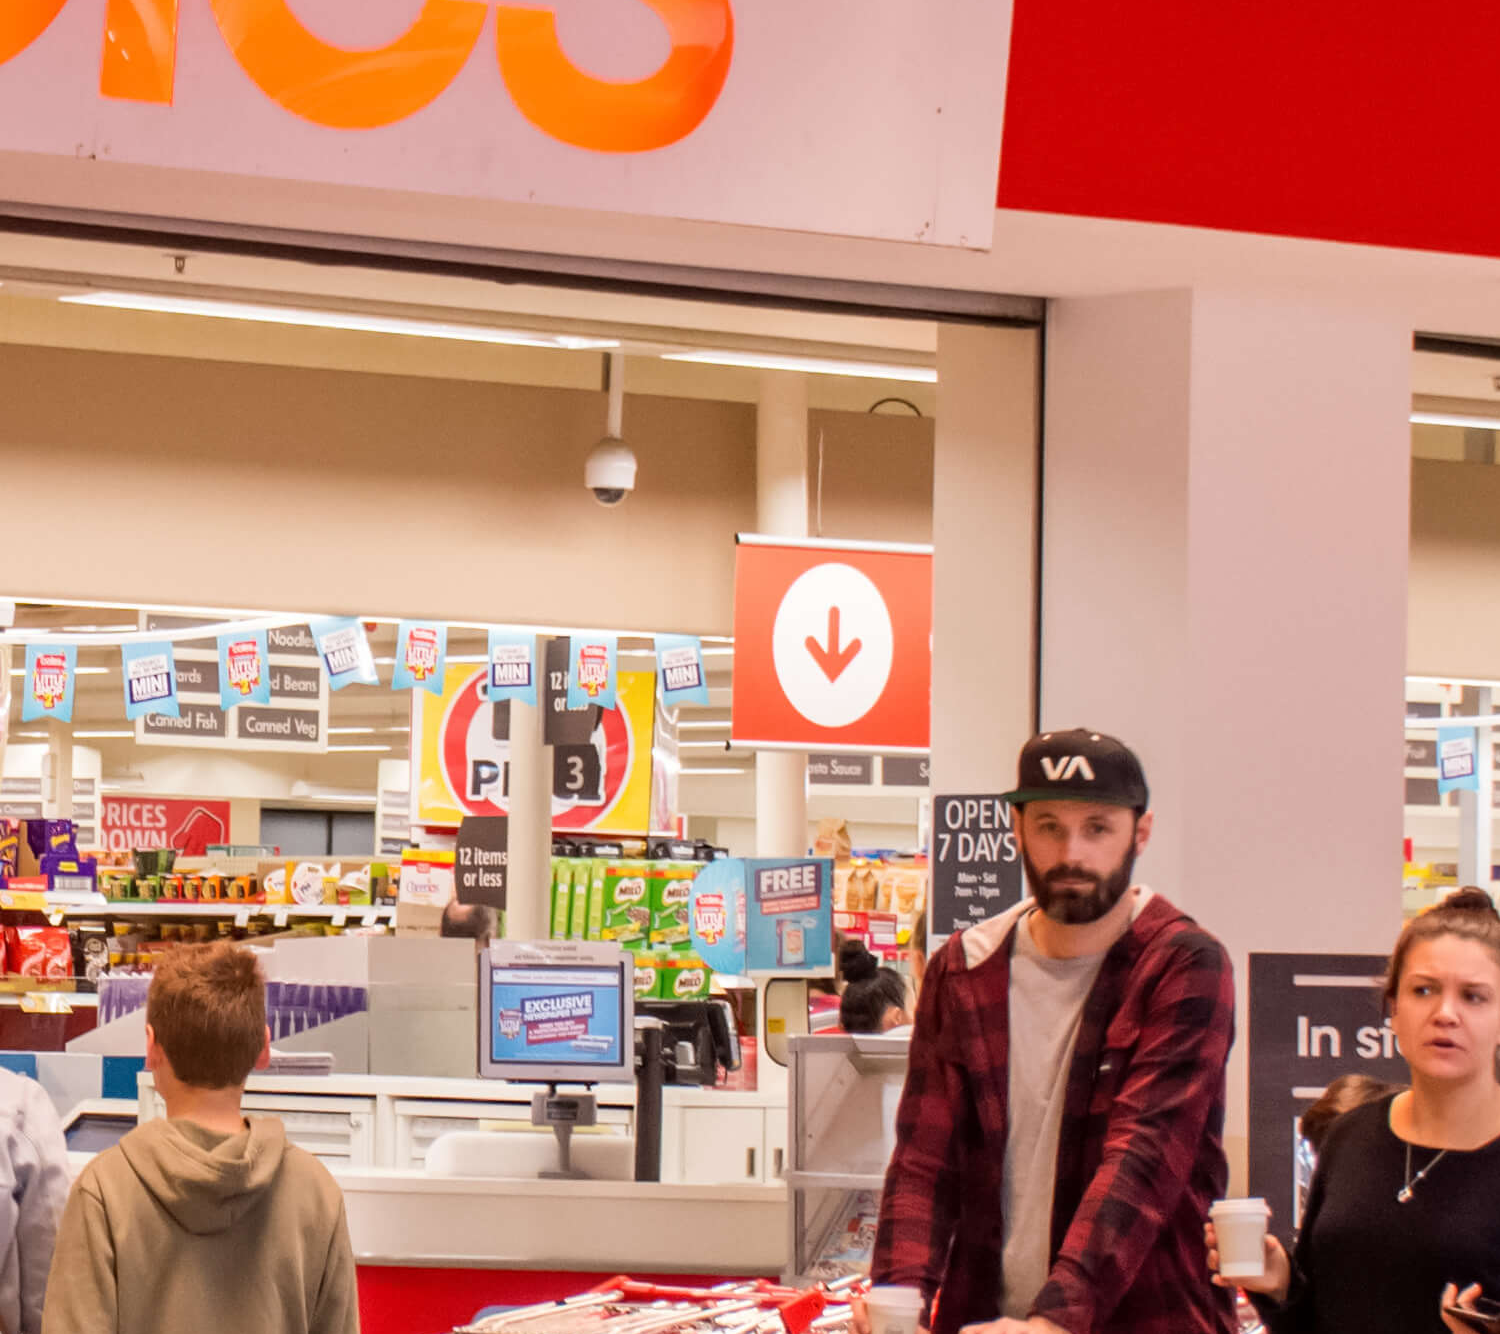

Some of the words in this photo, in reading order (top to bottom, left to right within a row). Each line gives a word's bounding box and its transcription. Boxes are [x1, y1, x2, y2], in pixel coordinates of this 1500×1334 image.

[328, 646, 361, 673] MIN
[495, 664, 529, 681] MINI
[550, 671, 562, 690] 12
[664, 665, 701, 689] MINI
[132, 673, 168, 697] MINI
[283, 674, 317, 692] Beans
[146, 712, 191, 729] Canned
[195, 714, 218, 730] Fish
[245, 716, 291, 734] Canned
[296, 719, 317, 739] Veg
[565, 755, 585, 790] 3
[830, 759, 863, 776] Sauce
[101, 803, 168, 828] RICES
[945, 799, 1012, 830] OPEN
[459, 848, 472, 866] 12
[474, 847, 508, 866] items
[938, 833, 951, 862] 7
[958, 832, 1018, 863] DAYS
[463, 873, 477, 887] or
[479, 868, 503, 887] less
[760, 865, 816, 893] FREE
[957, 872, 977, 884] Mon
[618, 884, 642, 897] MILO
[968, 905, 986, 917] Sun
[678, 974, 702, 988] MILO
[524, 993, 593, 1013] EXCLUSIVE
[1297, 1016, 1342, 1059] In
